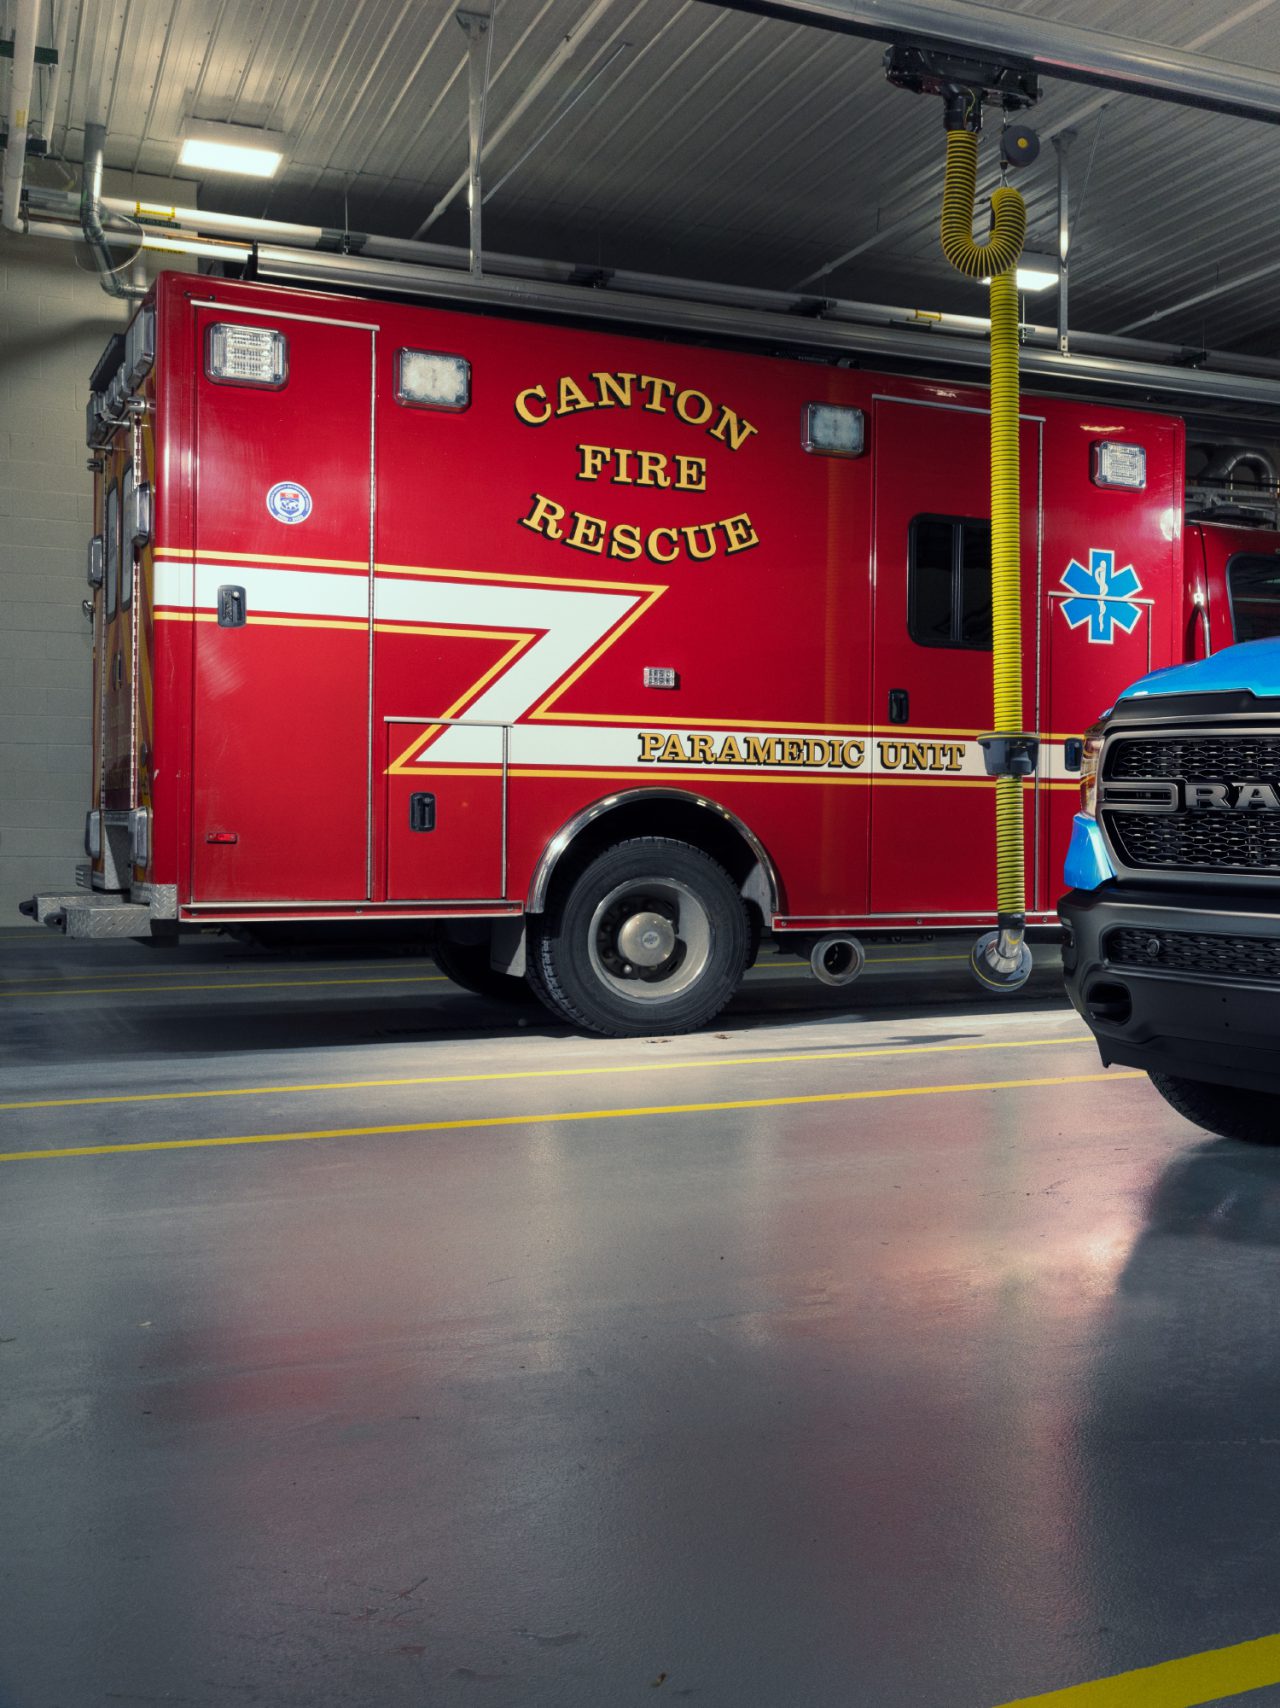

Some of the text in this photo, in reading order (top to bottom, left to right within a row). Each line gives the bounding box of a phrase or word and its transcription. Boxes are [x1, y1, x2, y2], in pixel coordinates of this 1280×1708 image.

[514, 372, 759, 451] CANTON
[575, 444, 707, 491] FIRE
[517, 493, 760, 564] RESCUE
[637, 732, 967, 771] PARAMEDIC UNIT
